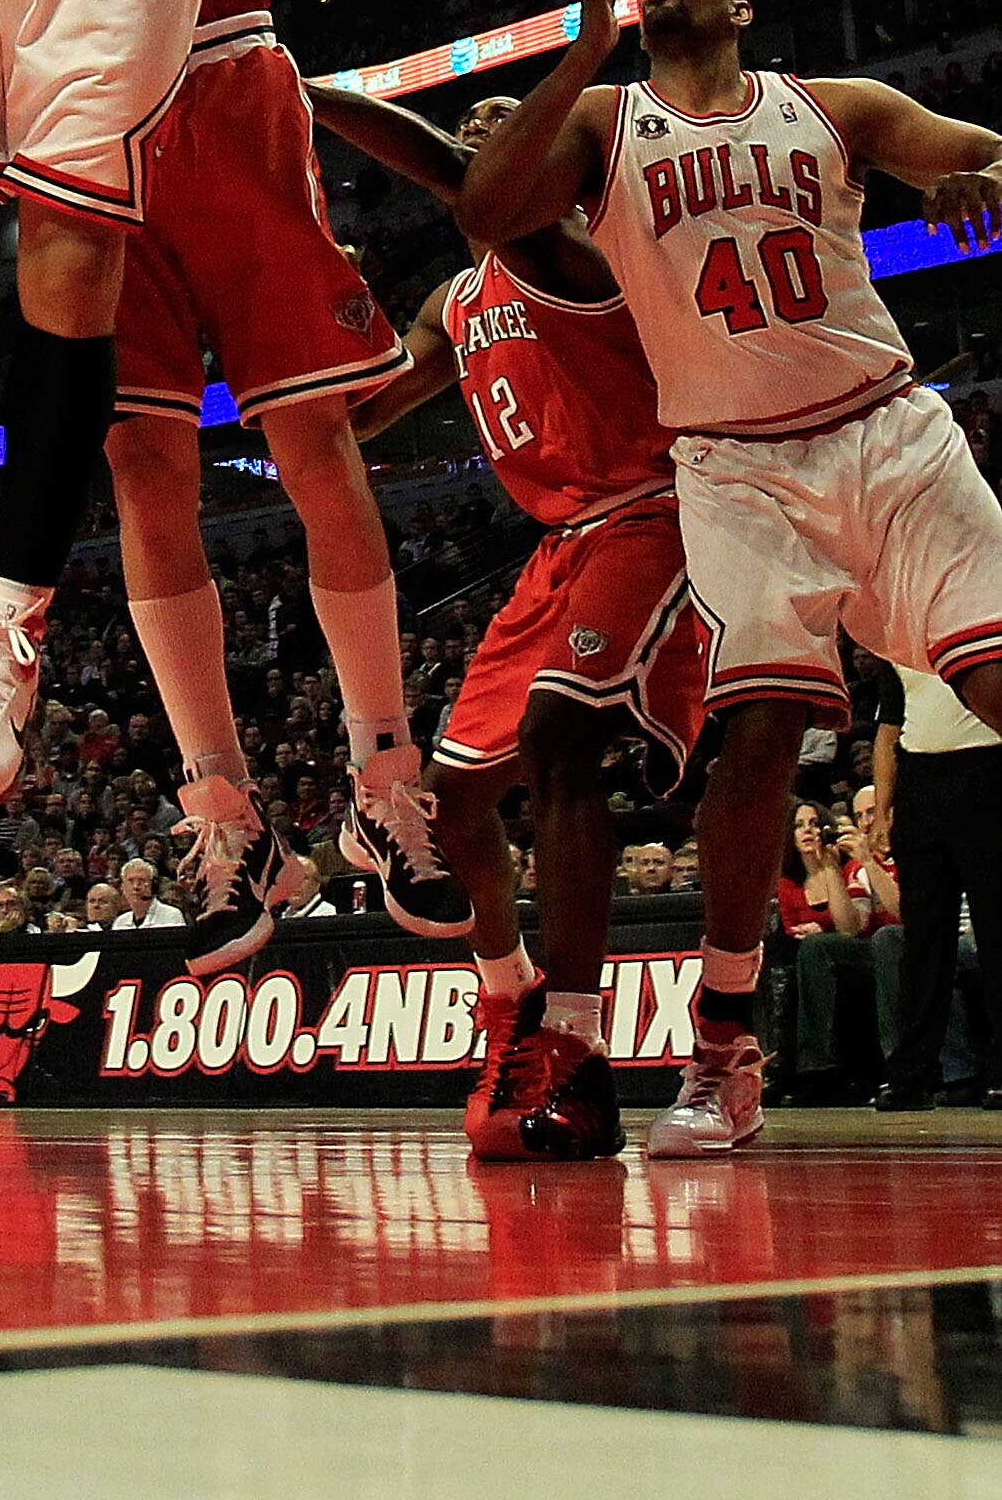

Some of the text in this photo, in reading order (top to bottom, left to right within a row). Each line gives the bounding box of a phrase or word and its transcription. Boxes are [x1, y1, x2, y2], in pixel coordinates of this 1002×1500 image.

[643, 142, 823, 240] BULLS
[695, 226, 830, 336] 40
[472, 376, 535, 461] 12
